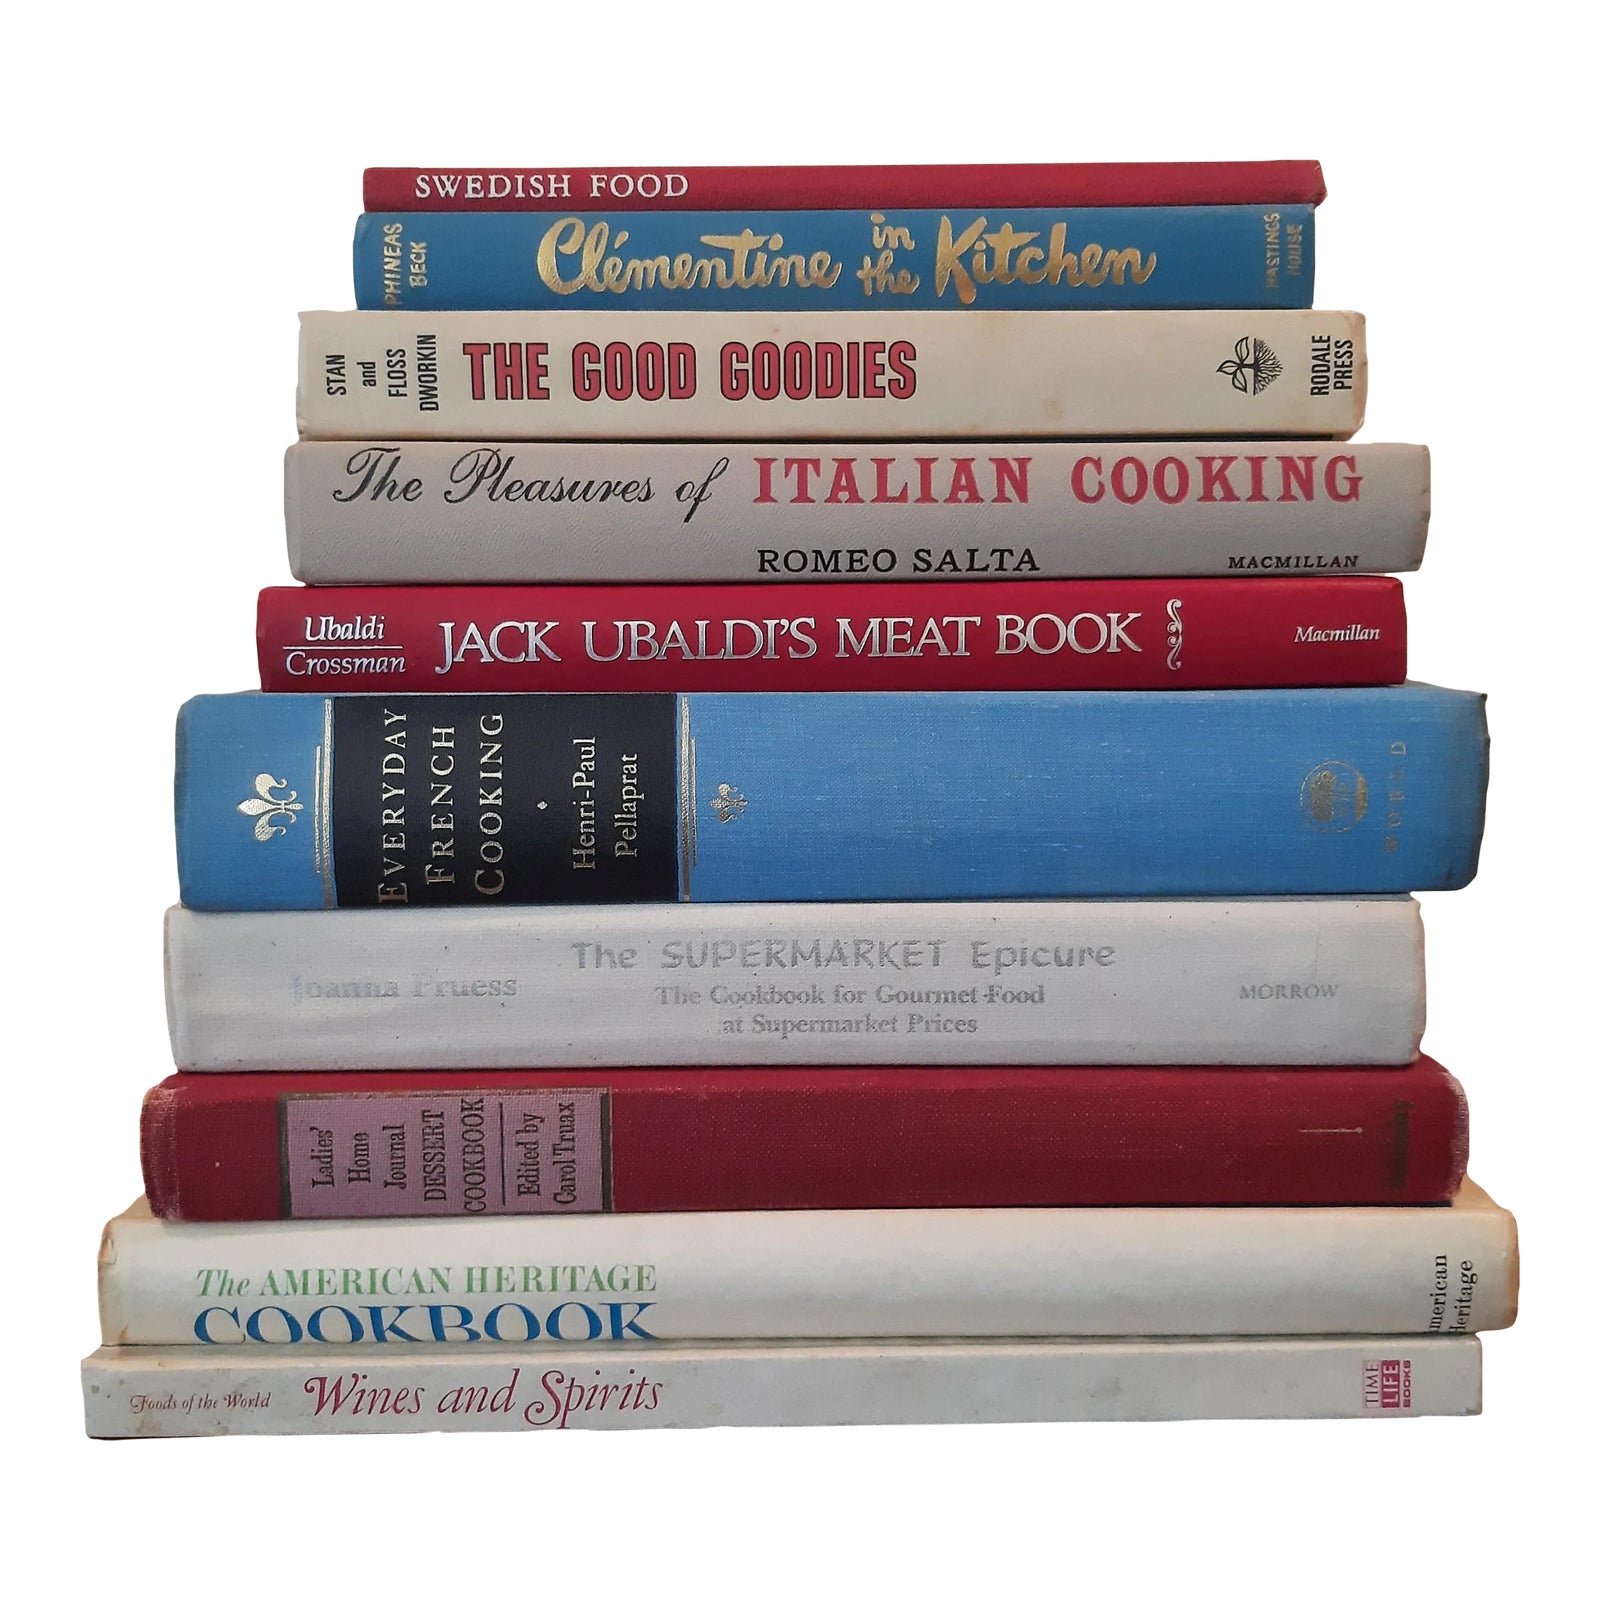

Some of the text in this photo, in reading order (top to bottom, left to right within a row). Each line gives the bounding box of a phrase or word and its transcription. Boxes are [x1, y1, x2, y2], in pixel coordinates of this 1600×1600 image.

[415, 173, 690, 199] SWEDISH FOOD
[537, 216, 843, 296] Clémentine
[870, 213, 916, 251] in
[1264, 211, 1281, 289] HASTINGS
[383, 222, 404, 305] PHINEAS
[408, 241, 429, 289] BECK
[856, 250, 920, 296] the
[935, 214, 1157, 305] Kitchen
[326, 353, 347, 396] STAN
[359, 360, 378, 388] and
[387, 347, 409, 399] FLOSS
[417, 333, 440, 412] DWORKIN
[462, 340, 918, 402] THE GOOD GOODIES
[1310, 335, 1331, 396] RODALE
[1333, 339, 1354, 390] PRESS
[332, 446, 1364, 523] The Pleasures of ITALIAN COOKING
[756, 547, 1041, 574] ROMEO SALTA
[1227, 554, 1360, 569] MACMILLAN
[304, 614, 387, 642] Ubaldi
[434, 611, 1143, 674] JACK UBALDI'S MEAT BOOK
[1293, 624, 1382, 643] Macmillan
[284, 650, 407, 677] Crossman
[377, 708, 409, 903] EVERYDAY
[425, 725, 456, 885] FRENCH
[474, 712, 506, 896] COOKING
[571, 736, 597, 870] Henri-Paul
[614, 752, 645, 858] Pellaprat
[571, 938, 1118, 978] The SUPERMARKET Epicure
[411, 972, 519, 1000] Pruess
[655, 983, 1046, 1006] The Cookbook for Gourmet Food
[1238, 983, 1340, 1002] MORROW
[722, 1012, 979, 1040] at Supermarket Prices
[310, 1125, 336, 1189] Ladies'
[348, 1131, 371, 1185] Home
[382, 1123, 408, 1190] Journal
[421, 1108, 449, 1203] DESSERT
[461, 1097, 486, 1213] COOKBOOK
[517, 1112, 545, 1197] Edited by
[552, 1101, 578, 1205] Carol Truax
[196, 1263, 658, 1298] The AMERICAN HERITAGE
[1428, 1254, 1448, 1332] merican
[193, 1301, 659, 1345] COOKBOOK
[130, 1391, 272, 1415] Foods of the World
[304, 1366, 665, 1430] Wines and Spirits
[1365, 1360, 1379, 1408] TIME
[1382, 1364, 1399, 1403] LIFE
[1402, 1359, 1411, 1408] BOOKS
